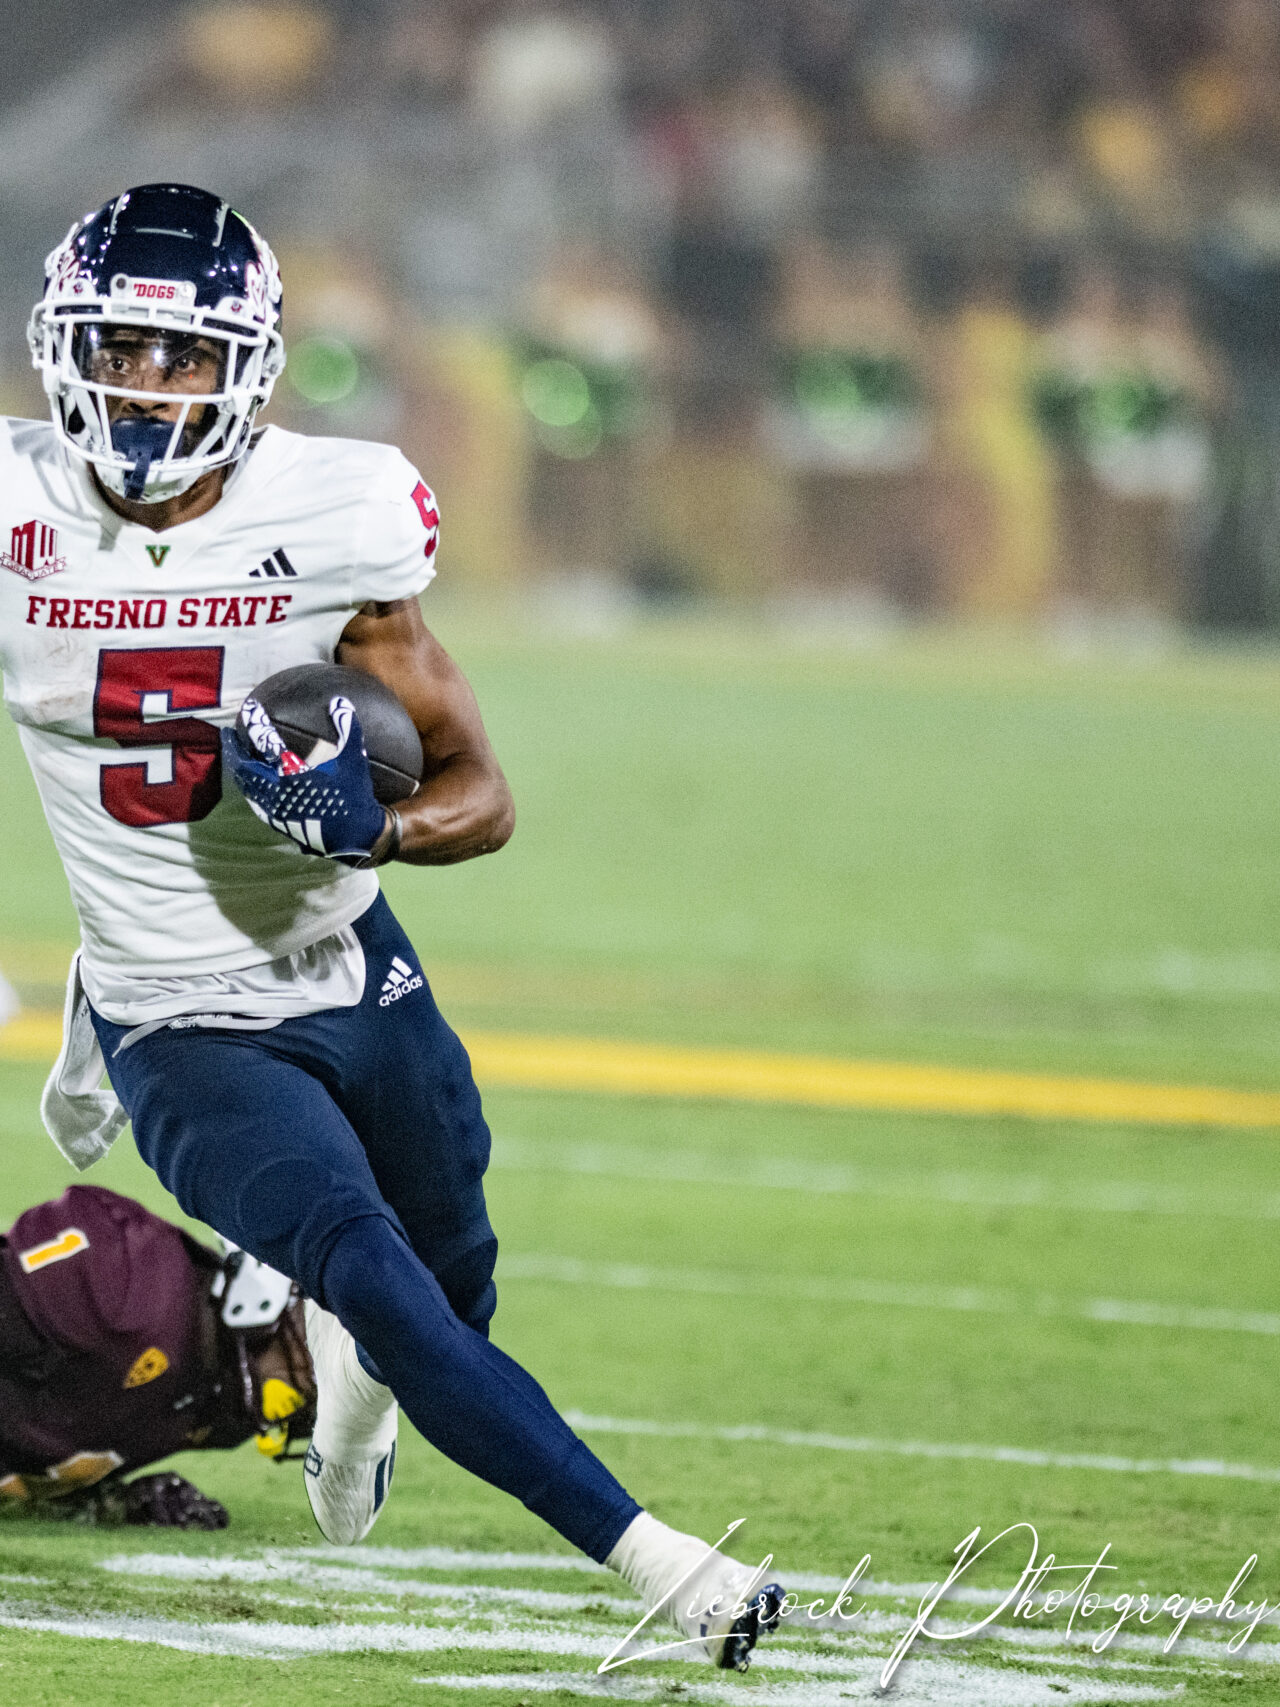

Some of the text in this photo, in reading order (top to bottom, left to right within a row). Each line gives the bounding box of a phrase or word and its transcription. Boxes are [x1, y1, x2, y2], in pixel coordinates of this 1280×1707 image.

[410, 480, 439, 559] 5
[145, 545, 171, 568] V
[26, 595, 292, 629] FRESNO STATE
[93, 646, 225, 828] 5
[379, 975, 423, 1006] adidas
[20, 1227, 90, 1274] 1
